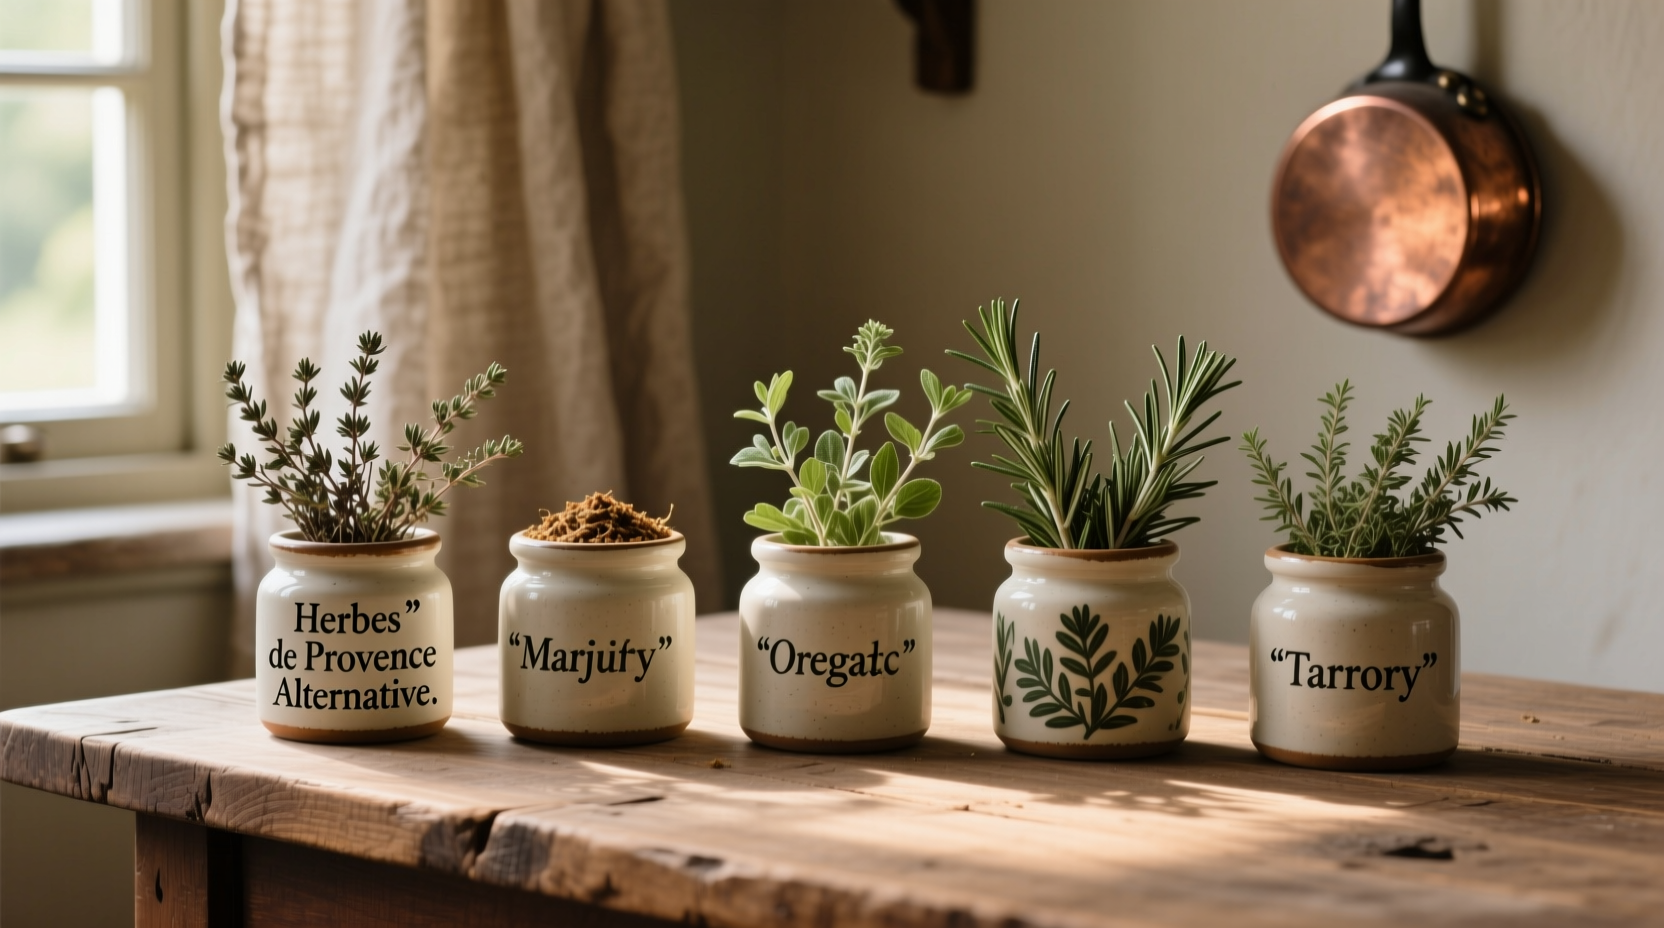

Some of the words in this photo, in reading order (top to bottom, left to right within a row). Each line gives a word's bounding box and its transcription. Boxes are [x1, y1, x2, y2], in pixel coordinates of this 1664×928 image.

[268, 638, 297, 671] de
[304, 645, 437, 673] Provence
[1270, 647, 1438, 703] “Tarrory”
[272, 676, 438, 711] Alternative.
